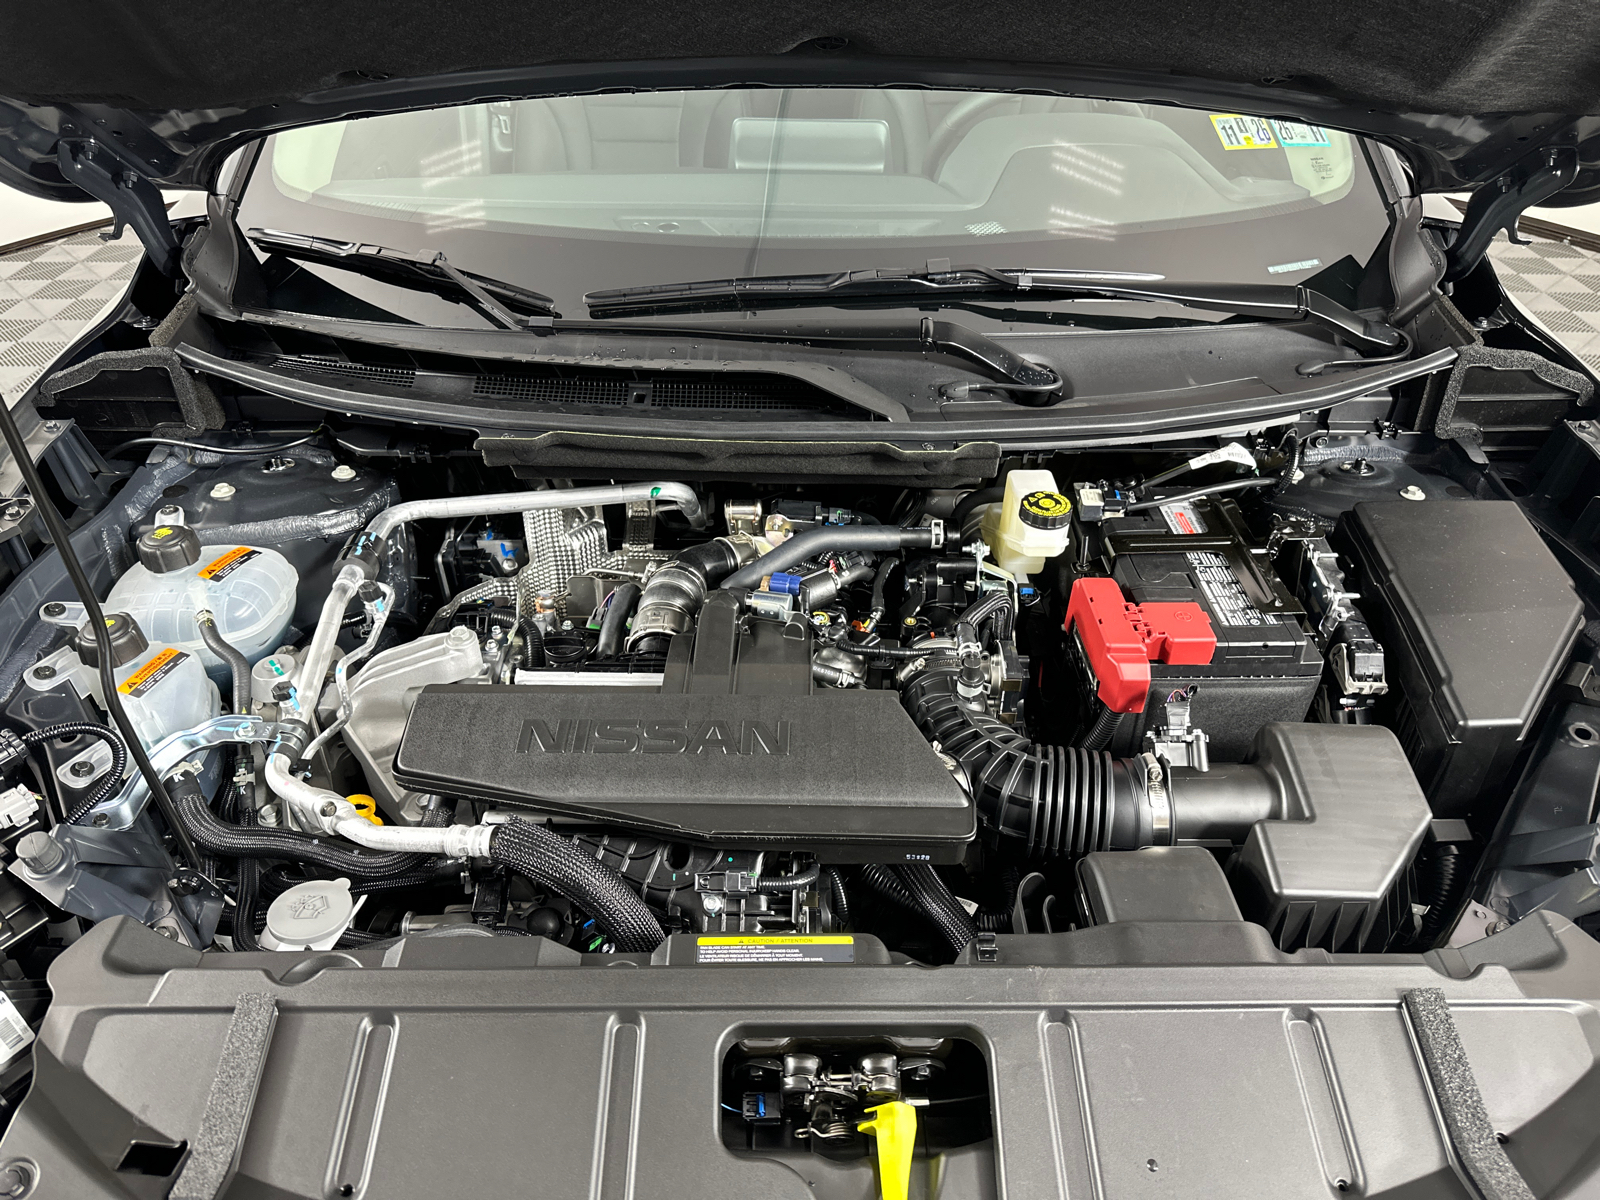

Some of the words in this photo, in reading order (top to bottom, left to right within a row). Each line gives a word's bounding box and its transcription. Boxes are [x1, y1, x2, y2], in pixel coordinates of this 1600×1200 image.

[1220, 124, 1241, 145] 11
[1250, 118, 1271, 142] 26
[1274, 120, 1294, 140] 26
[134, 662, 156, 679] WARNING
[515, 718, 791, 755] NISSAN
[173, 773, 185, 783] K
[240, 786, 246, 795] K
